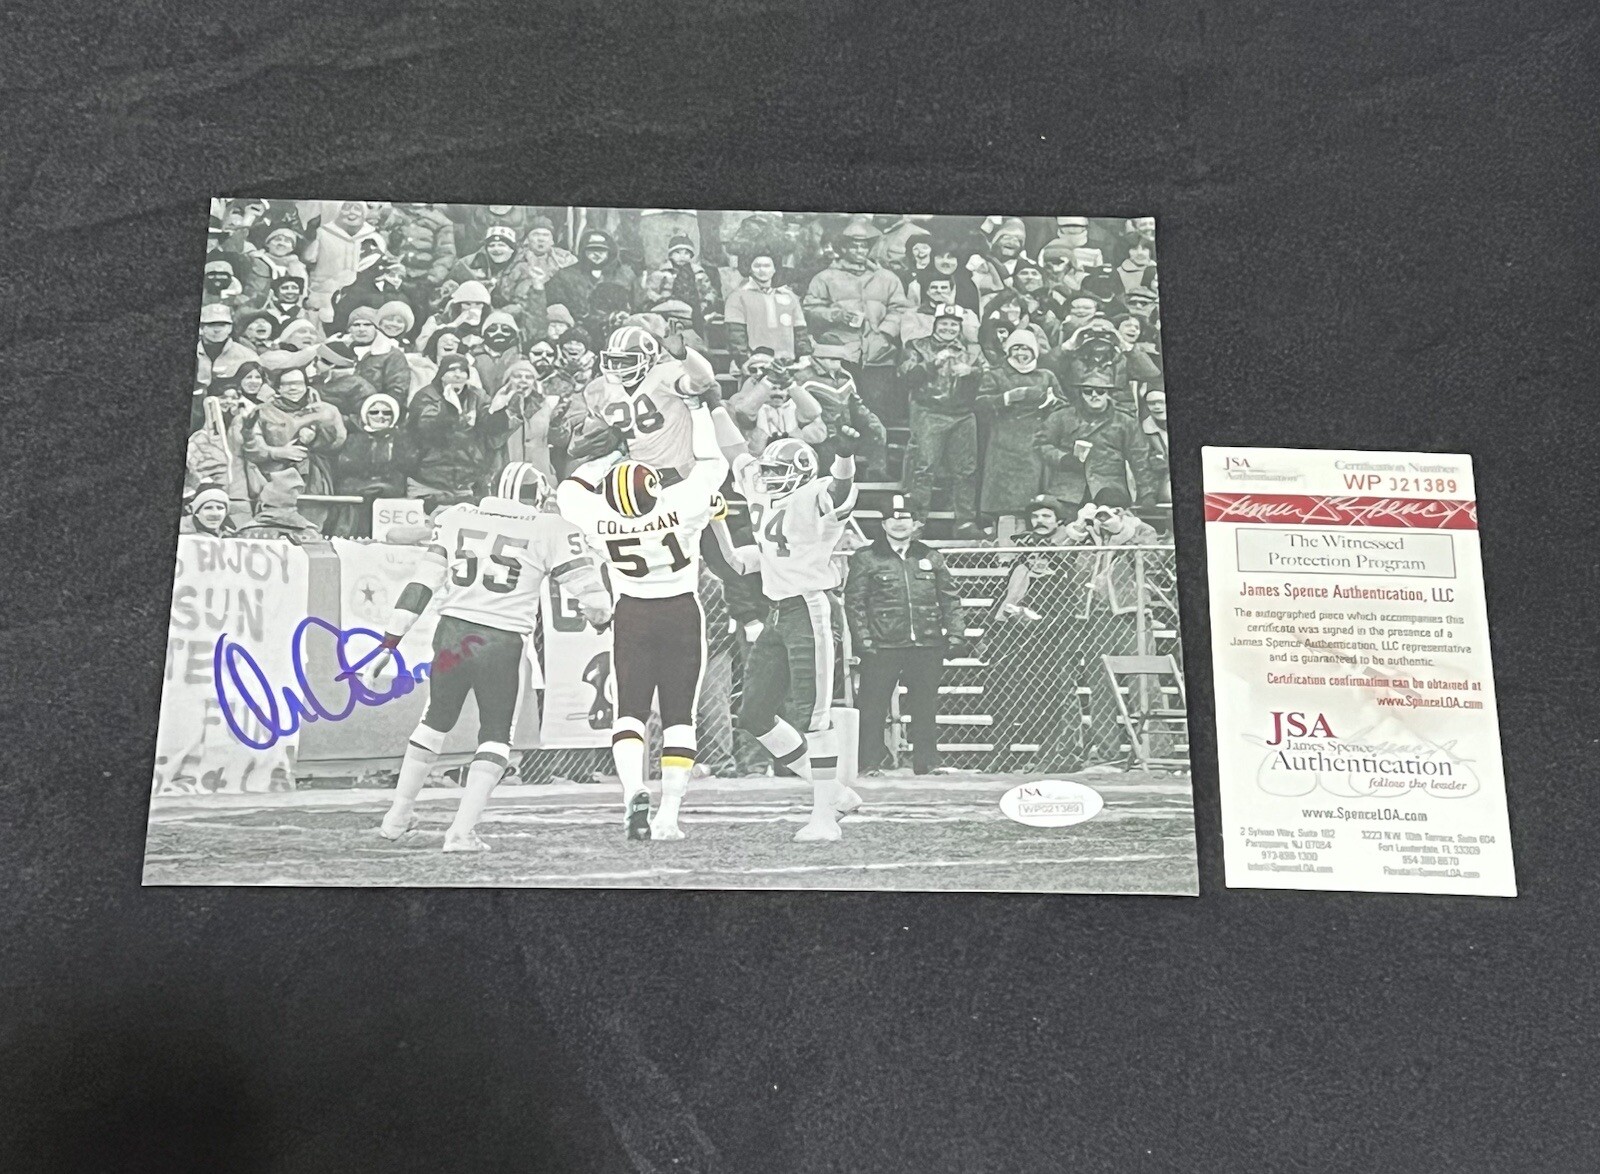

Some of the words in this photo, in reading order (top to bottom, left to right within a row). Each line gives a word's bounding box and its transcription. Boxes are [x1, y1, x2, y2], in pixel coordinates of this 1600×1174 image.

[1223, 456, 1250, 470] JSA
[1343, 473, 1381, 490] WP
[379, 510, 419, 525] SEC
[1284, 533, 1319, 548] The
[1321, 534, 1405, 550] Witnessed
[194, 540, 290, 584] ENJOY
[451, 528, 529, 593] 55
[605, 532, 692, 578] 51
[1268, 552, 1351, 567] Protection
[1357, 555, 1426, 572] Program
[1240, 582, 1280, 596] James
[1284, 583, 1328, 601] Spence
[1333, 584, 1428, 603] Authentication,
[1432, 587, 1454, 603] LLC
[171, 585, 264, 642] SUN
[1234, 607, 1252, 617] The
[1255, 610, 1316, 621] autographed
[1347, 612, 1377, 621] which
[1247, 623, 1296, 634] certificate
[1298, 626, 1319, 634] was
[1322, 626, 1354, 636] signed
[1357, 626, 1366, 635] in
[1369, 626, 1385, 636] the
[1387, 628, 1431, 638] presence
[1434, 629, 1444, 638] of
[1230, 637, 1263, 646] James
[1265, 638, 1301, 648] Spence
[1382, 641, 1399, 651] LLC
[1401, 643, 1472, 654] representative
[1269, 653, 1288, 662] and
[1290, 654, 1299, 662] is
[1301, 655, 1357, 665] guaranteed
[1360, 656, 1370, 665] to
[1372, 655, 1385, 665] be
[1267, 672, 1326, 686] Certification
[1392, 679, 1409, 689] can
[1412, 677, 1424, 689] be
[1427, 679, 1469, 691] obtained
[1471, 681, 1482, 691] at
[1266, 711, 1338, 746] JSA
[1286, 739, 1324, 750] James
[1327, 741, 1376, 755] Spence
[1271, 751, 1452, 776] Authentication
[1409, 779, 1427, 788] the
[1431, 779, 1467, 790] leader
[1302, 807, 1428, 821] www.SpenceLOA.com
